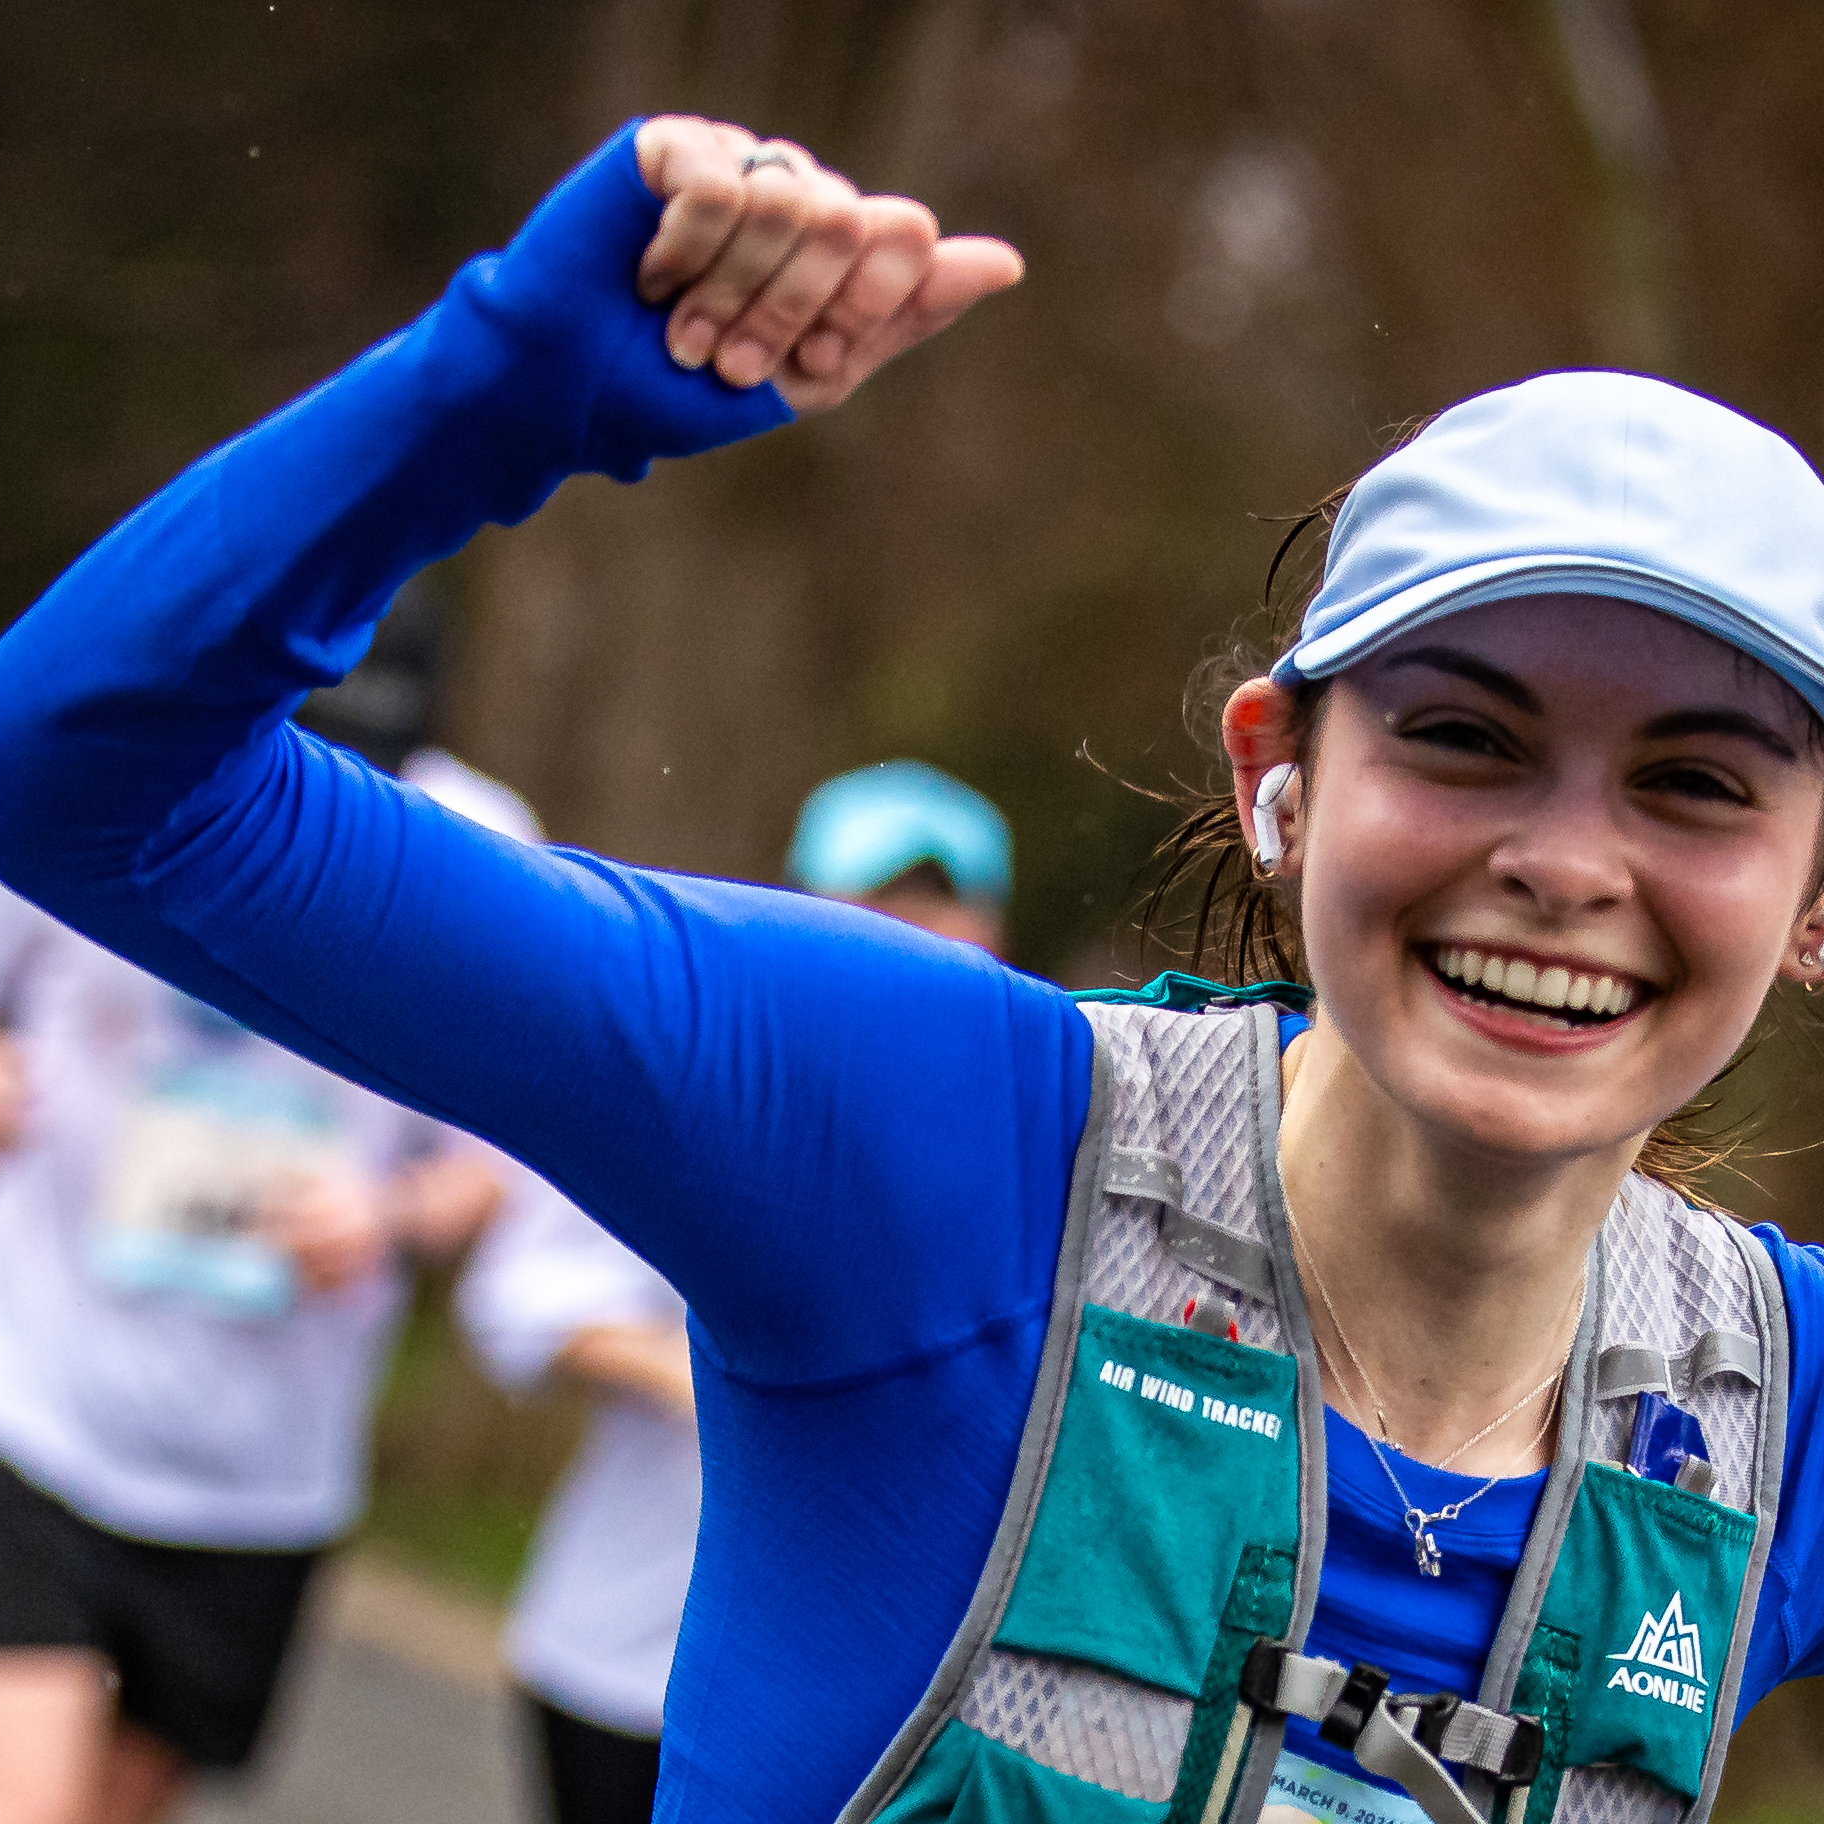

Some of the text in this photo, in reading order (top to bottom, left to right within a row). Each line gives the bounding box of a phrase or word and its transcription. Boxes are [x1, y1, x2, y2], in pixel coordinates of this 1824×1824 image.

[1099, 1360, 1282, 1442] AIR WIND TRACKE
[1606, 1666, 1707, 1714] AONIJIE
[1272, 1775, 1335, 1811] MARCH
